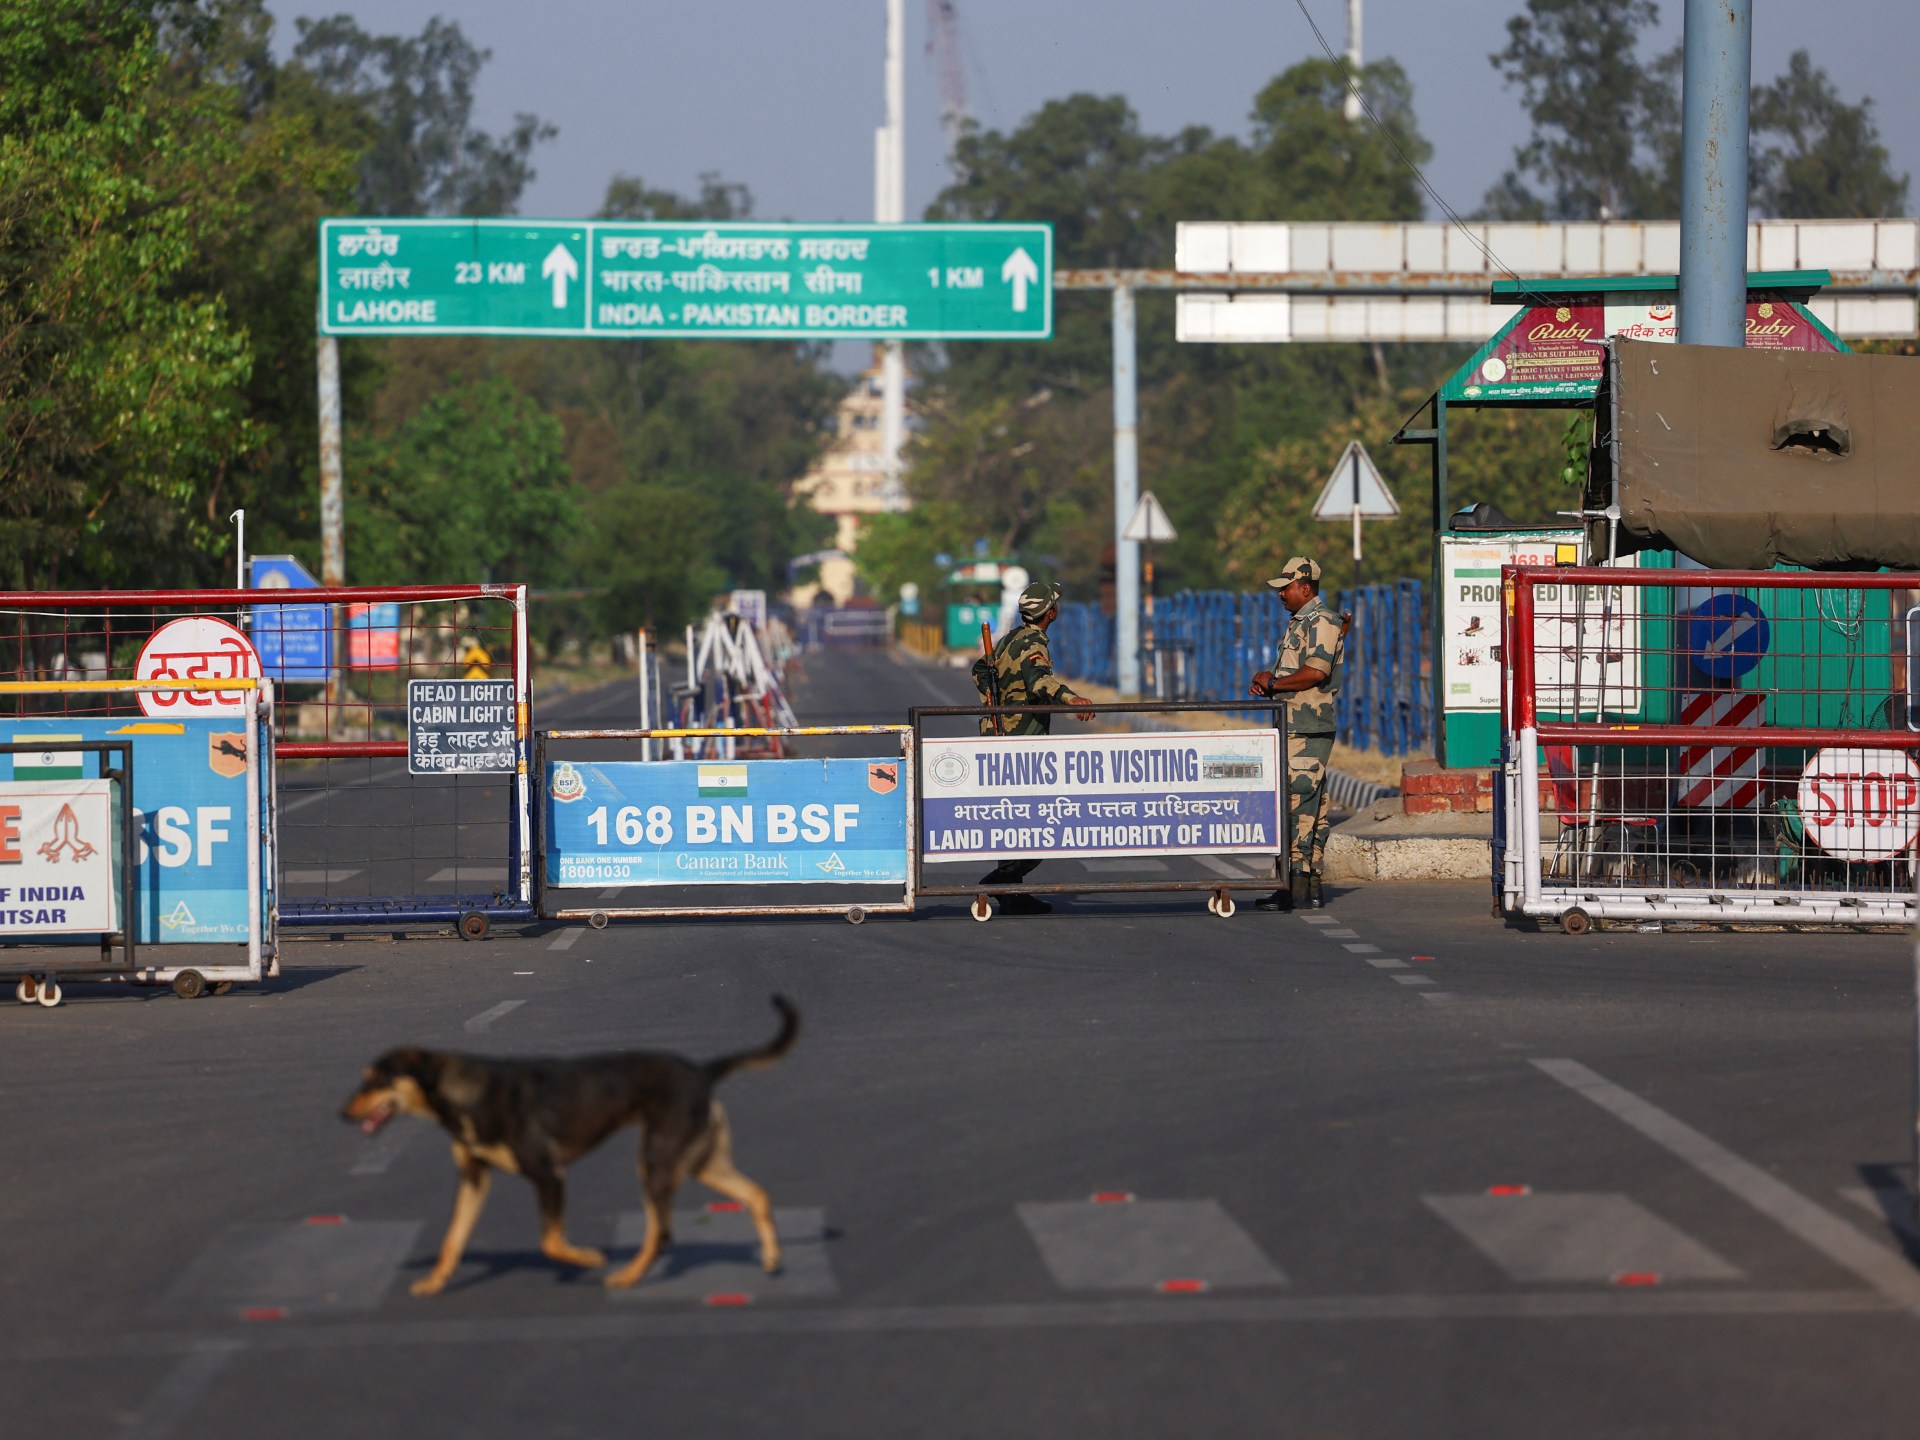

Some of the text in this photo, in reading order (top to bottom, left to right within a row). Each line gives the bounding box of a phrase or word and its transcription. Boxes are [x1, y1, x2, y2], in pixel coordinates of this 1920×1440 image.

[337, 260, 411, 292] लाहौर
[455, 262, 525, 284] 23 KM
[803, 264, 862, 294] सीमा
[928, 268, 983, 289] 1 KM
[337, 300, 437, 323] LAHORE
[599, 304, 664, 325] INDIA
[682, 304, 798, 326] PAKISTAN
[806, 304, 907, 327] BORDER
[1528, 322, 1593, 341] Ruby
[1512, 351, 1548, 359] DESIGNER
[150, 637, 252, 706] ठहरो
[413, 685, 456, 702] HEAD
[461, 685, 503, 701] LIGHT
[1480, 696, 1499, 704] Super
[412, 706, 457, 723] CABIN
[461, 706, 503, 723] LIGHT
[415, 726, 441, 752] हेड
[445, 731, 489, 752] लाइट
[459, 752, 497, 770] लाइट
[975, 751, 1057, 786] THANKS
[1064, 750, 1104, 784] FOR
[1110, 748, 1198, 784] VISITING
[952, 794, 1240, 825] भारतीय भूमि पत्तन प्राधिकरण
[1811, 772, 1916, 827] STOP
[587, 803, 860, 846] 168 BN BSF
[929, 823, 1266, 850] LAND PORTS AUTHORITY OF INDIA
[560, 865, 631, 878] 18001030
[676, 853, 788, 869] Canara Bank
[833, 869, 861, 877] Together
[20, 886, 84, 901] INDIA
[0, 909, 66, 925] ITSAR
[180, 925, 249, 935] Together We Ca
